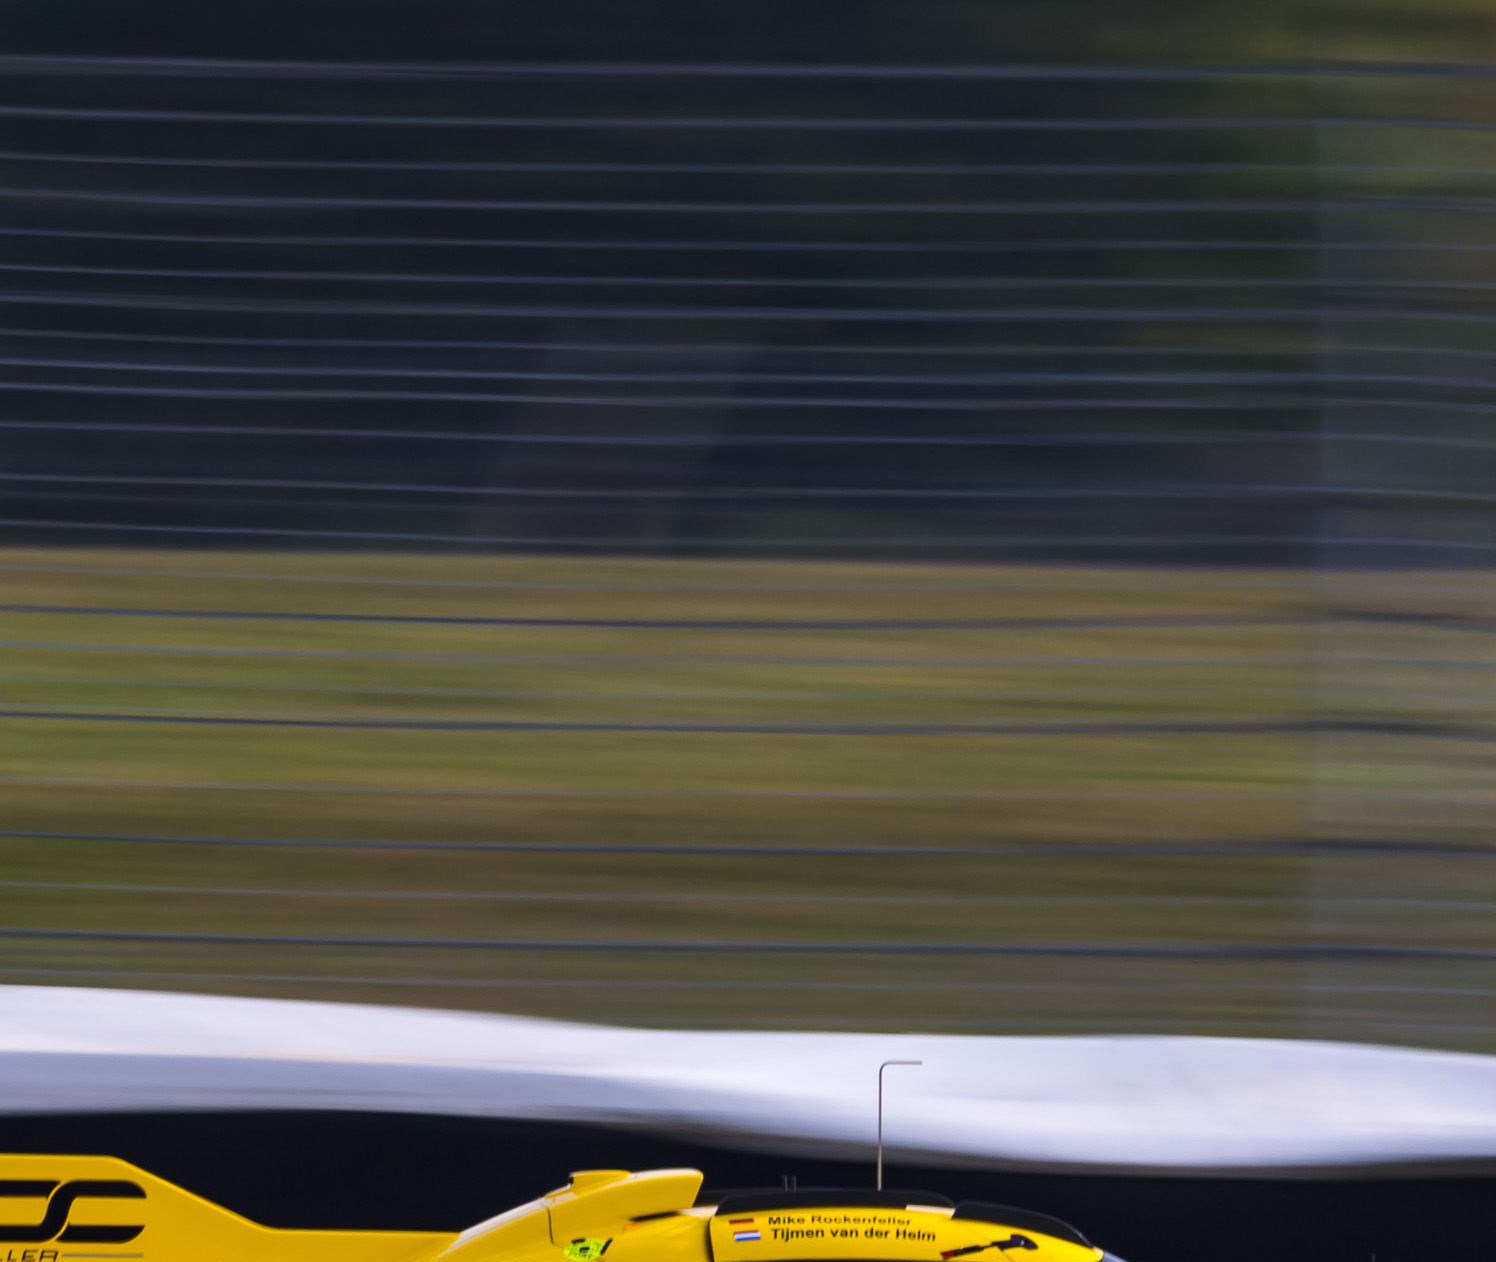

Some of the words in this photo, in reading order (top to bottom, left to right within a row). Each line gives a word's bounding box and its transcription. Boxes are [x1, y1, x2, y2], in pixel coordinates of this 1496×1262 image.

[768, 1216, 805, 1225] Mike
[811, 1215, 911, 1226] Rockenfeller
[771, 1228, 825, 1242] Tijmen
[830, 1229, 859, 1238] van
[864, 1228, 890, 1239] der
[896, 1228, 936, 1242] Helm
